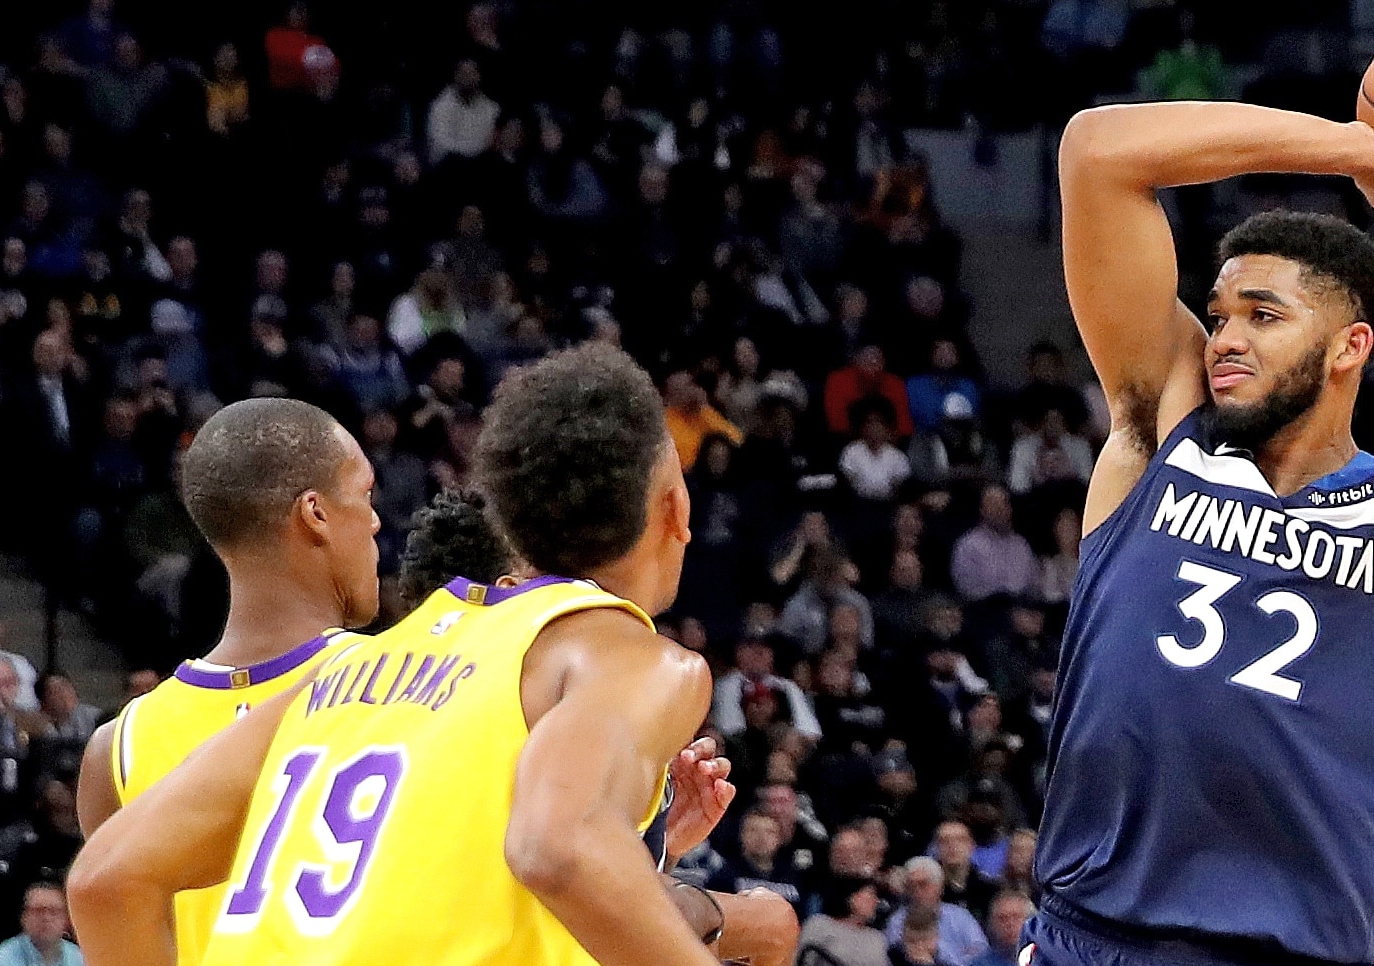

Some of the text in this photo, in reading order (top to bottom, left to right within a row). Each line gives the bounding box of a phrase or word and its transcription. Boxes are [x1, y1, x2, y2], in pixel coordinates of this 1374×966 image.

[1150, 482, 1374, 594] MINNESOTA
[1328, 483, 1374, 505] fitbit
[305, 652, 477, 718] WILLIAMS
[1156, 560, 1318, 701] 32
[224, 748, 406, 922] 19
